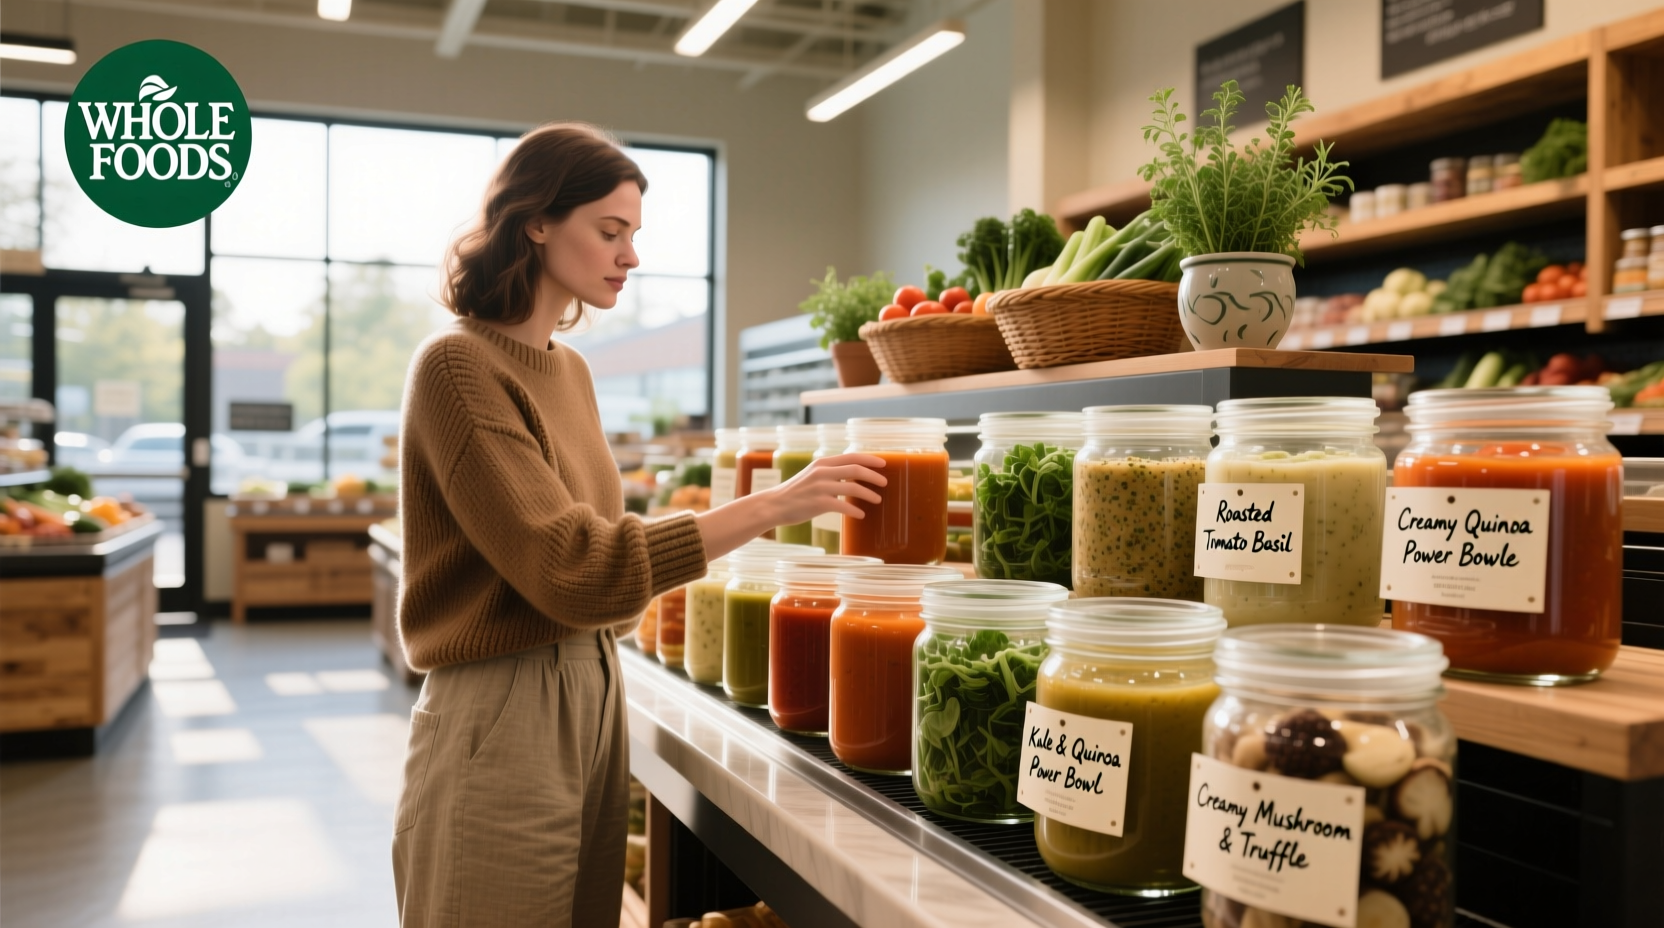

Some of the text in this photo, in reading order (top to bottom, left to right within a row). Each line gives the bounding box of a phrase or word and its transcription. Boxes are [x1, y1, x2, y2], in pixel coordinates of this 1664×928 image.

[1216, 499, 1275, 523] Roasted
[1398, 507, 1534, 542] Creamy Quinoa
[1251, 530, 1293, 553] Basil
[1403, 539, 1520, 568] Power Bowle
[1055, 733, 1067, 757] &
[1071, 737, 1121, 768] Quinoa
[1064, 766, 1103, 794] Bowl
[1197, 782, 1352, 840] Creamy Mushroom
[1219, 827, 1309, 873] & Truffle
